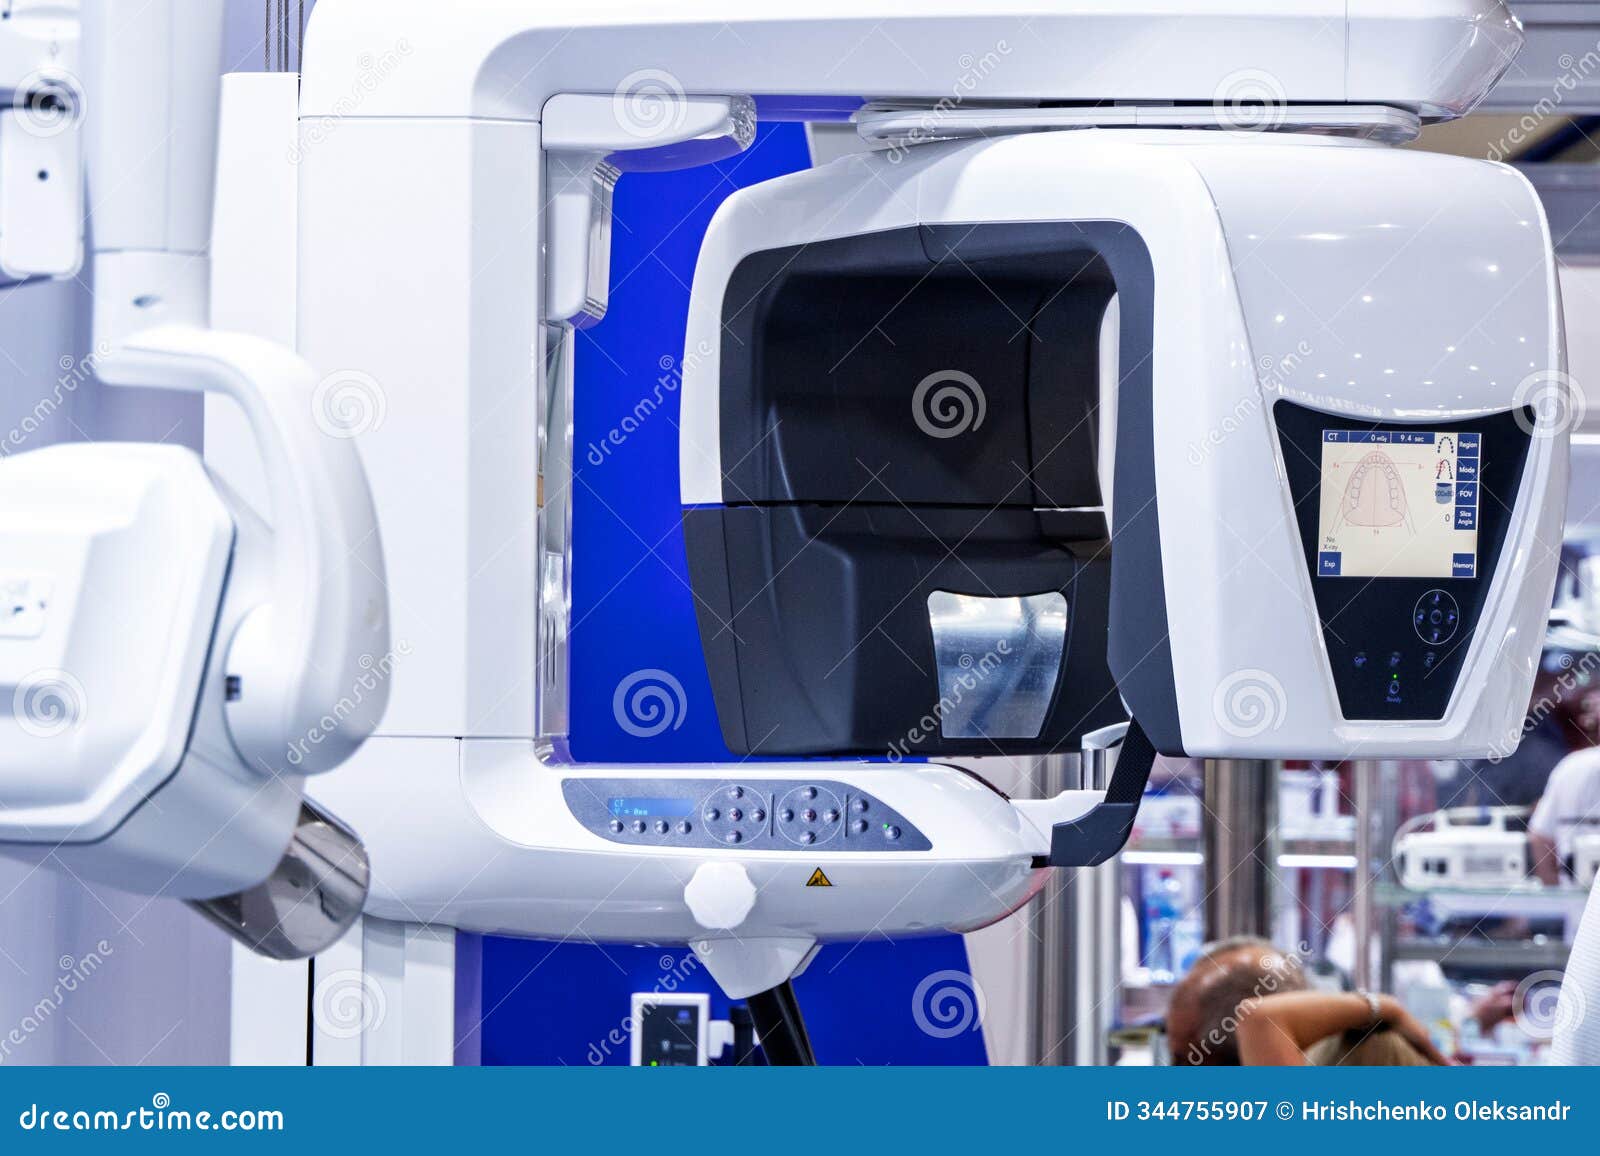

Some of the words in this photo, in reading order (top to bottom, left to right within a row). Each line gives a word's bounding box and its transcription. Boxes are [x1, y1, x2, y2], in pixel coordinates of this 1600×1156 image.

[1328, 433, 1338, 441] CT
[1459, 441, 1478, 450] Region
[1459, 490, 1473, 498] FOV
[1324, 560, 1336, 569] Exp
[1453, 562, 1474, 571] Memory
